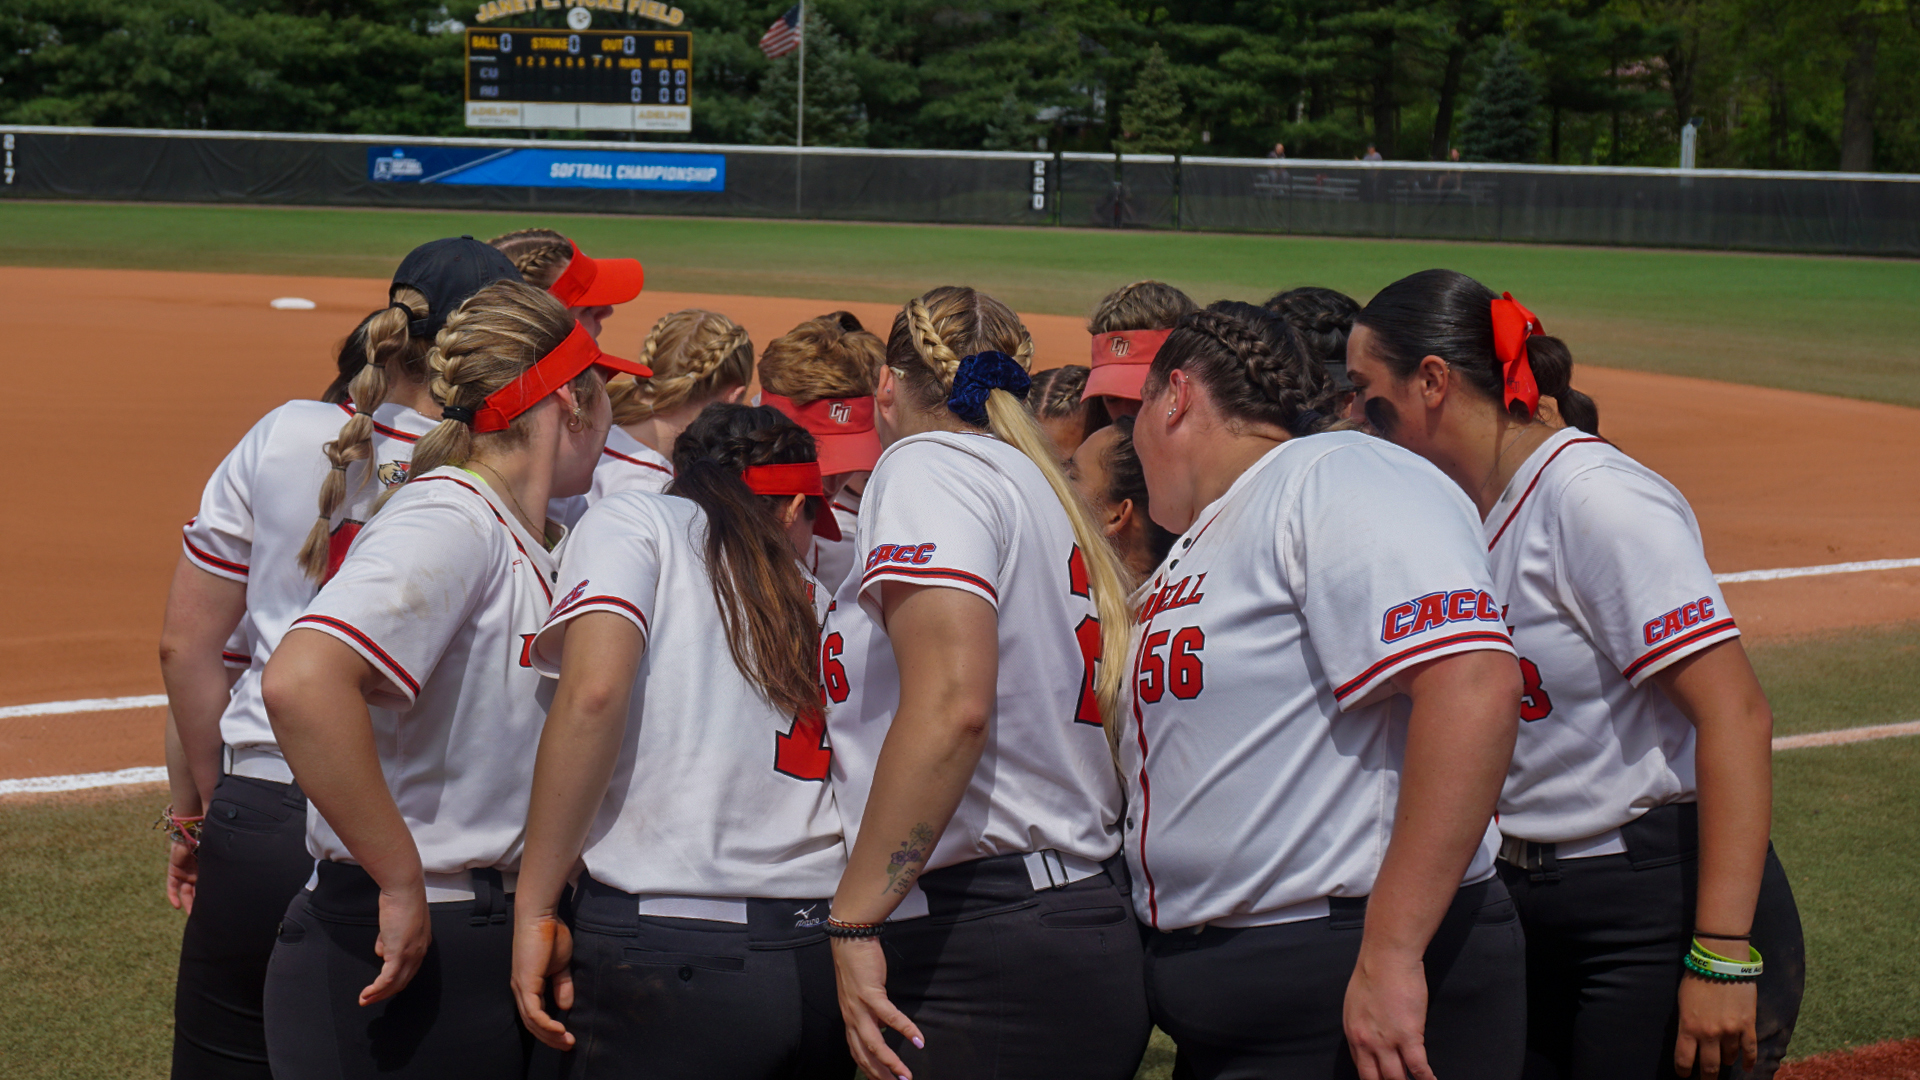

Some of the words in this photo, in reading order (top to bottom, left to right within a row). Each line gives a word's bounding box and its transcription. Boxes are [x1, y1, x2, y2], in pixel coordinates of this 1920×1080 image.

[627, 0, 684, 27] FIELD
[471, 36, 498, 49] BALL
[500, 33, 512, 53] 0
[531, 37, 568, 51] STRIKE
[568, 34, 580, 54] 0
[601, 39, 624, 52] OUT
[623, 35, 636, 55] 0
[630, 69, 642, 85] 0
[659, 69, 670, 85] 0
[674, 69, 686, 86] 0
[630, 87, 642, 103] 0
[658, 87, 670, 103] 0
[674, 88, 686, 103] 0
[550, 163, 613, 179] SOFTBALL
[616, 165, 718, 182] CHAMPIONSHIP
[1033, 160, 1046, 210] 220
[1110, 336, 1131, 357] CU
[828, 401, 852, 424] CU
[865, 542, 937, 574] CACC
[1380, 588, 1500, 645] CACC
[1643, 596, 1715, 647] CACC
[1139, 626, 1206, 705] 56
